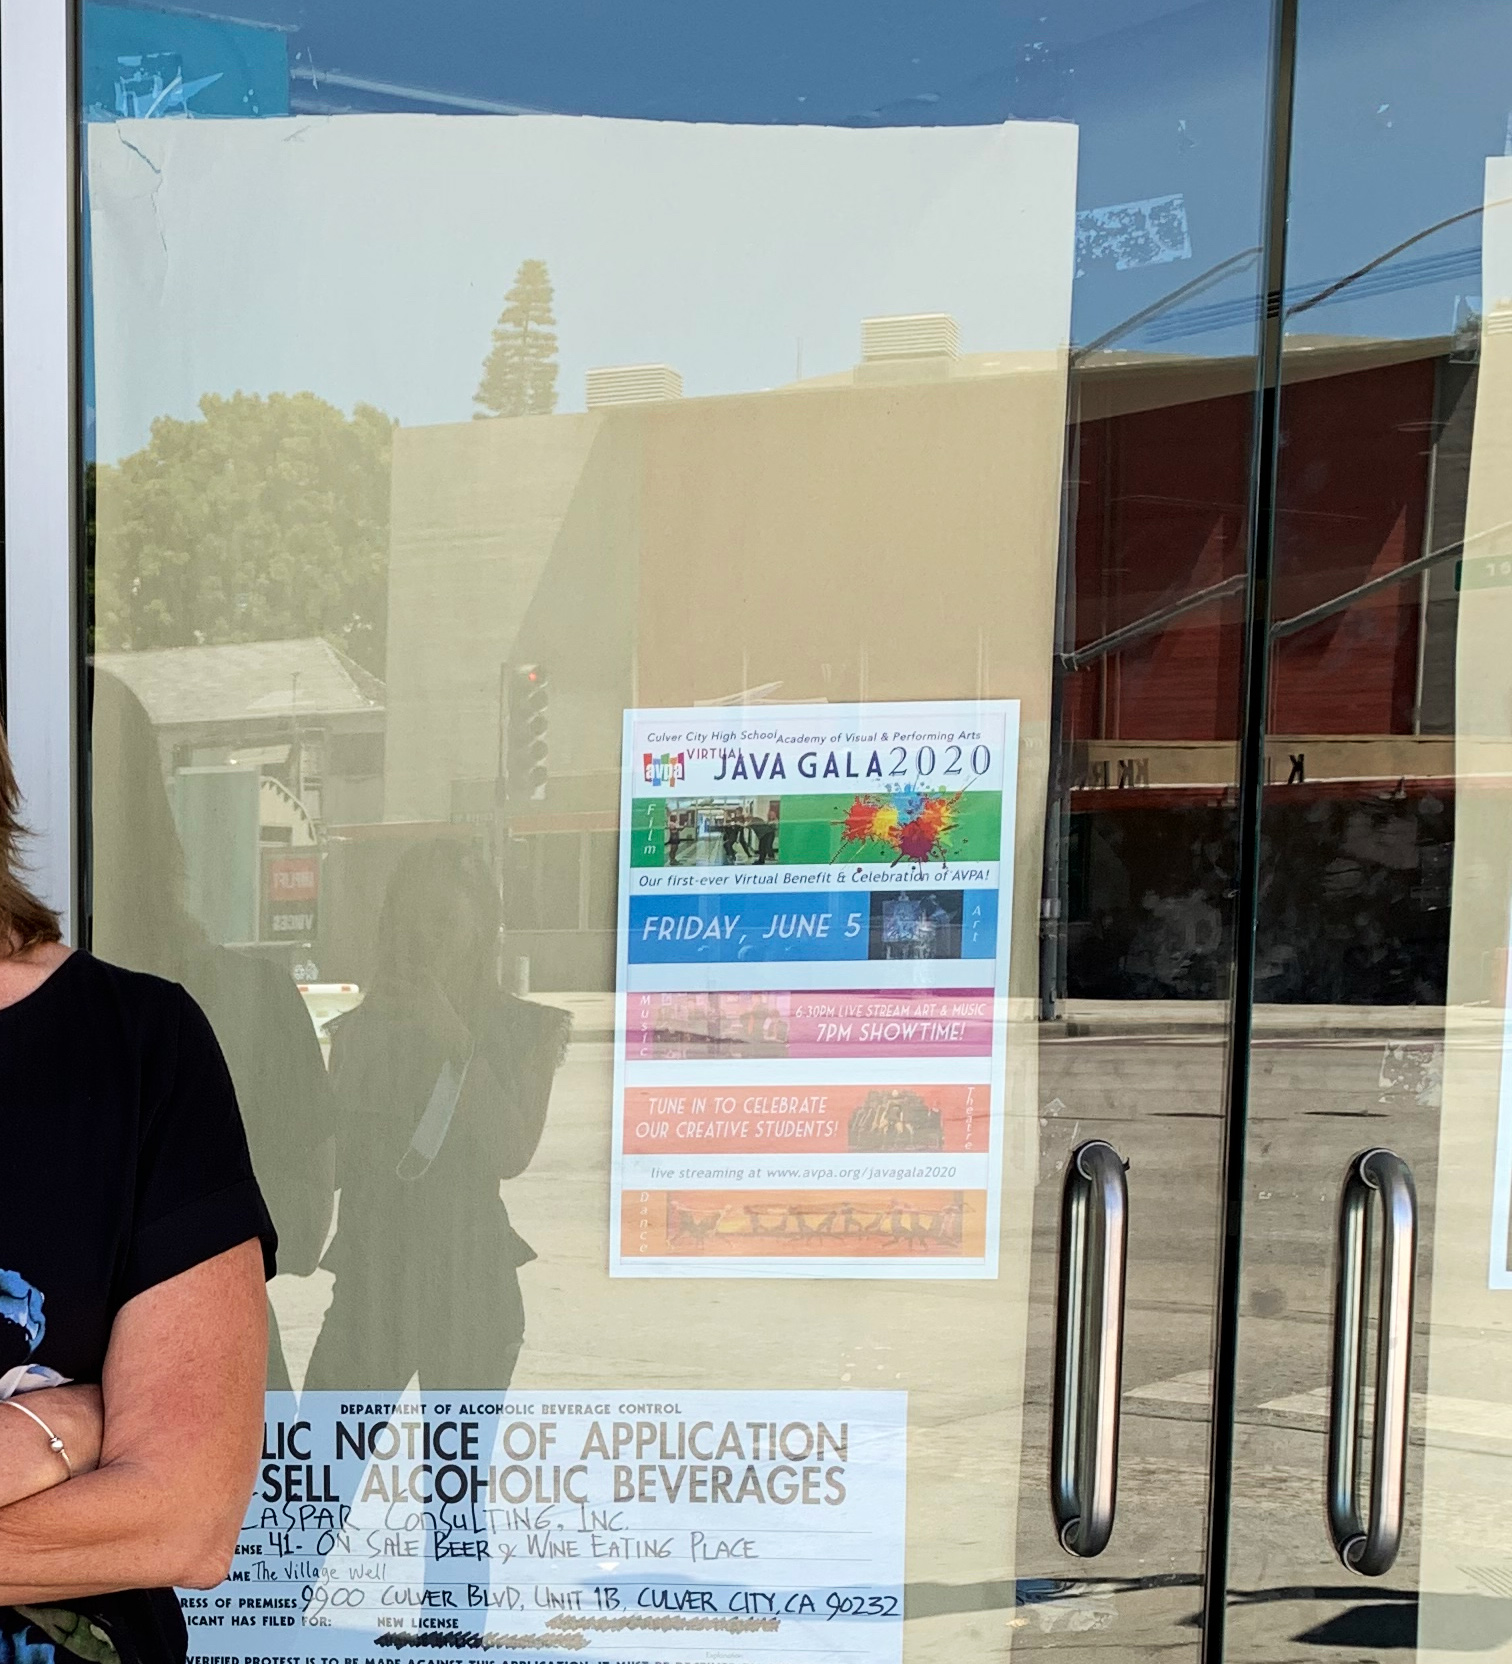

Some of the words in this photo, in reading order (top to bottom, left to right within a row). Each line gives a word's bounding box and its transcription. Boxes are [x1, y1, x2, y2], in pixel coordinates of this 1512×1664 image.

[647, 732, 682, 743] Culver
[686, 731, 708, 744] City
[711, 731, 737, 743] High
[740, 729, 778, 741] School
[776, 733, 827, 746] Academy
[845, 732, 877, 742] Visual
[892, 731, 955, 743] Performing
[958, 730, 981, 741] Arts
[686, 747, 745, 760] VIRTUAL
[713, 751, 787, 781] JAVA
[797, 750, 883, 779] GALA
[888, 744, 991, 777] 2020
[643, 803, 657, 856] Film
[639, 875, 662, 887] Our
[667, 874, 730, 887] first-ever
[734, 873, 779, 885] Virtual
[783, 871, 832, 884] Benefit
[851, 871, 930, 883] Celebration
[934, 869, 948, 882] of
[951, 869, 990, 882] AVPA!
[642, 914, 747, 945] FRIDAY,
[762, 913, 833, 939] JUNE
[843, 912, 863, 939] 5
[838, 1004, 862, 1018] LIVE
[865, 1004, 910, 1017] STREAM
[913, 1003, 937, 1017] ART
[952, 1002, 987, 1017] MUSIC
[816, 1022, 853, 1042] 7PM
[858, 1021, 967, 1042] SHOWTIME!
[647, 1096, 686, 1115] TUNE
[690, 1096, 707, 1114] IN
[712, 1096, 737, 1114] TO
[742, 1096, 829, 1114] CELEBRATE
[635, 1121, 670, 1139] OUR
[675, 1120, 750, 1139] CREATIVE
[754, 1120, 839, 1139] STUDENTS!
[651, 1166, 675, 1179] live
[678, 1166, 744, 1181] streaming
[747, 1167, 762, 1179] at
[767, 1165, 957, 1181] www.avpa.org/javagala2020
[340, 1403, 427, 1416] DEPARTMENT
[433, 1403, 453, 1416] OF
[459, 1403, 535, 1416] ALCOHOLIC
[541, 1403, 612, 1416] BEVERAGE
[618, 1403, 683, 1415] CONTROL
[335, 1420, 480, 1461] NOTICE
[502, 1421, 558, 1461] OF
[579, 1420, 849, 1463] APPLICATION
[261, 1463, 340, 1503] SELL
[360, 1463, 589, 1504] ALCOHOLIC
[612, 1463, 847, 1506] BEVERAGES
[316, 1529, 352, 1556] ON
[366, 1528, 421, 1560] SALE
[434, 1530, 491, 1561] BEER
[526, 1529, 581, 1560] WINE
[591, 1533, 675, 1560] EATING
[690, 1531, 760, 1562] PLACE
[251, 1561, 278, 1582] The
[284, 1561, 340, 1586] Village
[349, 1562, 387, 1581] Well
[214, 1598, 232, 1609] OF
[238, 1598, 298, 1610] PREMISES
[301, 1584, 366, 1619] 9900
[381, 1584, 456, 1608] CULVER
[534, 1584, 583, 1611] UNIT
[637, 1585, 719, 1613] CULVER
[784, 1592, 816, 1614] CA
[825, 1591, 903, 1621] 90232
[231, 1615, 257, 1627] HAS
[262, 1616, 296, 1627] FILED
[301, 1616, 332, 1628] FOR:
[376, 1617, 407, 1629] NEW
[410, 1617, 460, 1630] LICENSE
